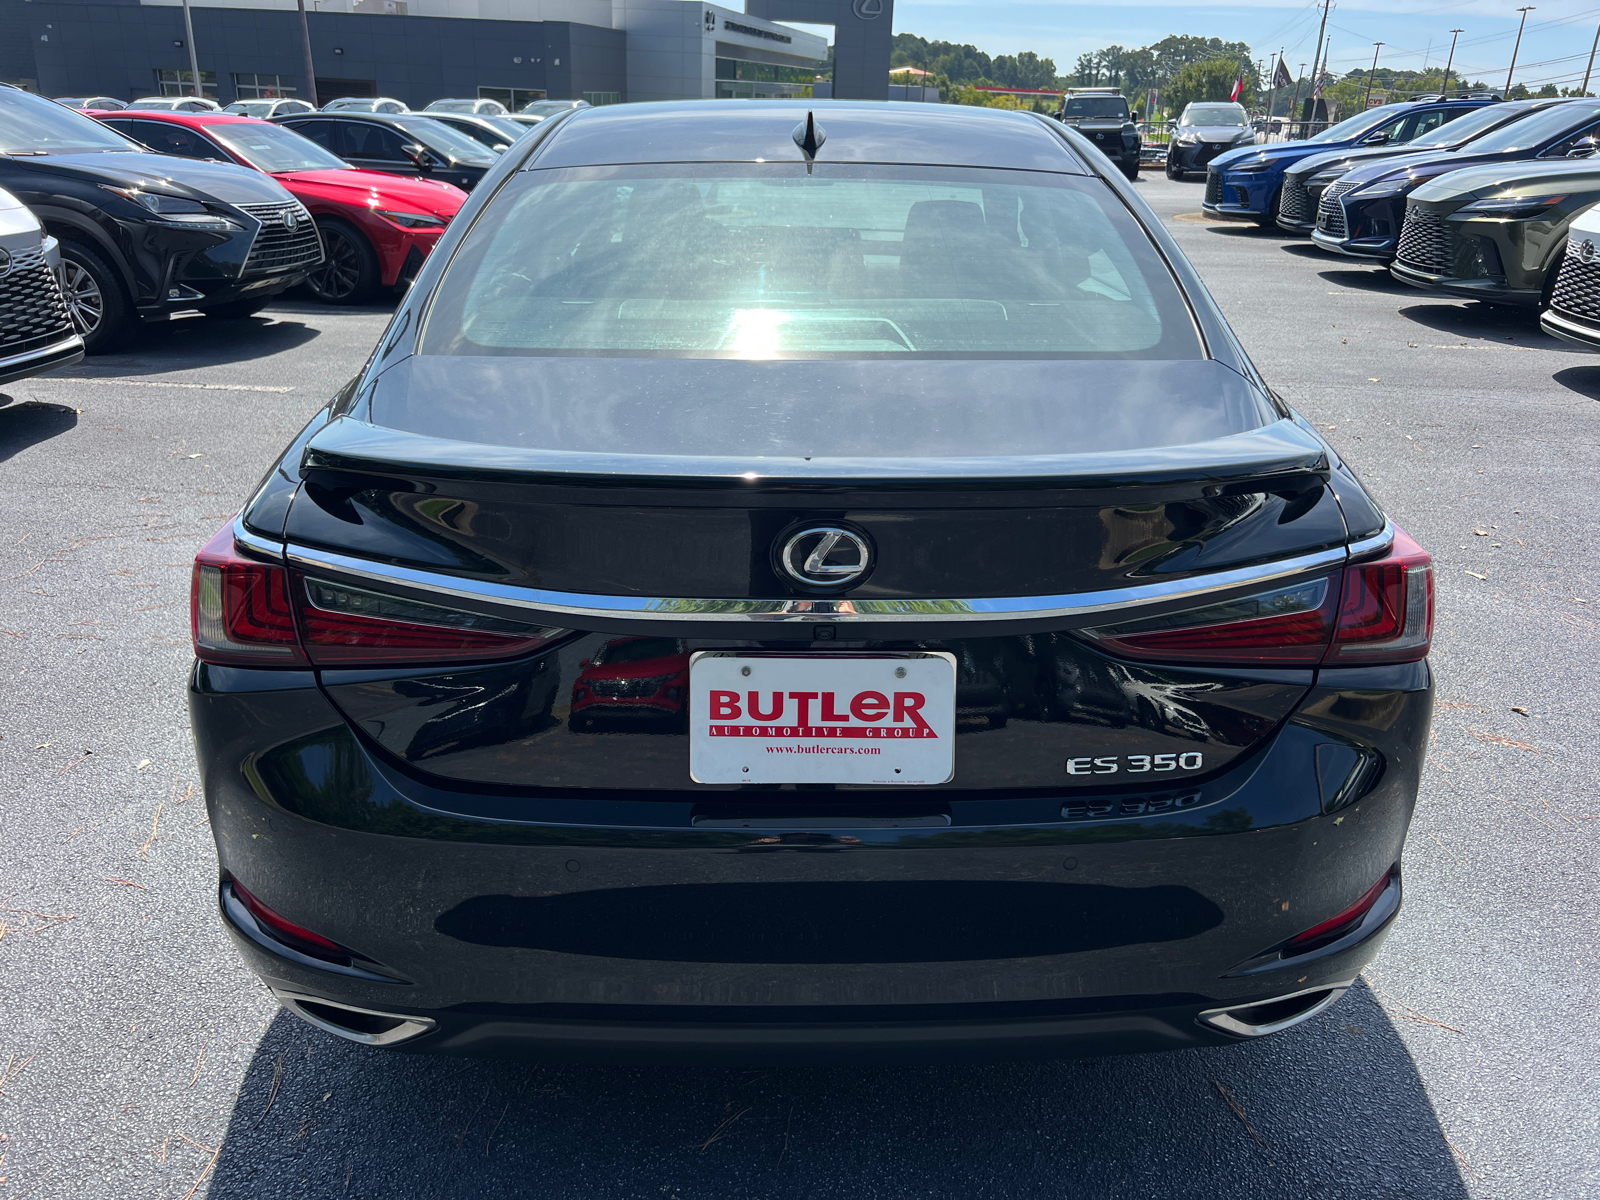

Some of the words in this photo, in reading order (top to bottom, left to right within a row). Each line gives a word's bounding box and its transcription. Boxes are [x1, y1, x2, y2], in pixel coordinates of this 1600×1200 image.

[710, 726, 843, 737] AUTOMOTIVE
[866, 727, 930, 737] GROUP
[765, 744, 881, 755] www.butlercars.com
[1066, 757, 1119, 775] ES
[1126, 752, 1203, 773] 350
